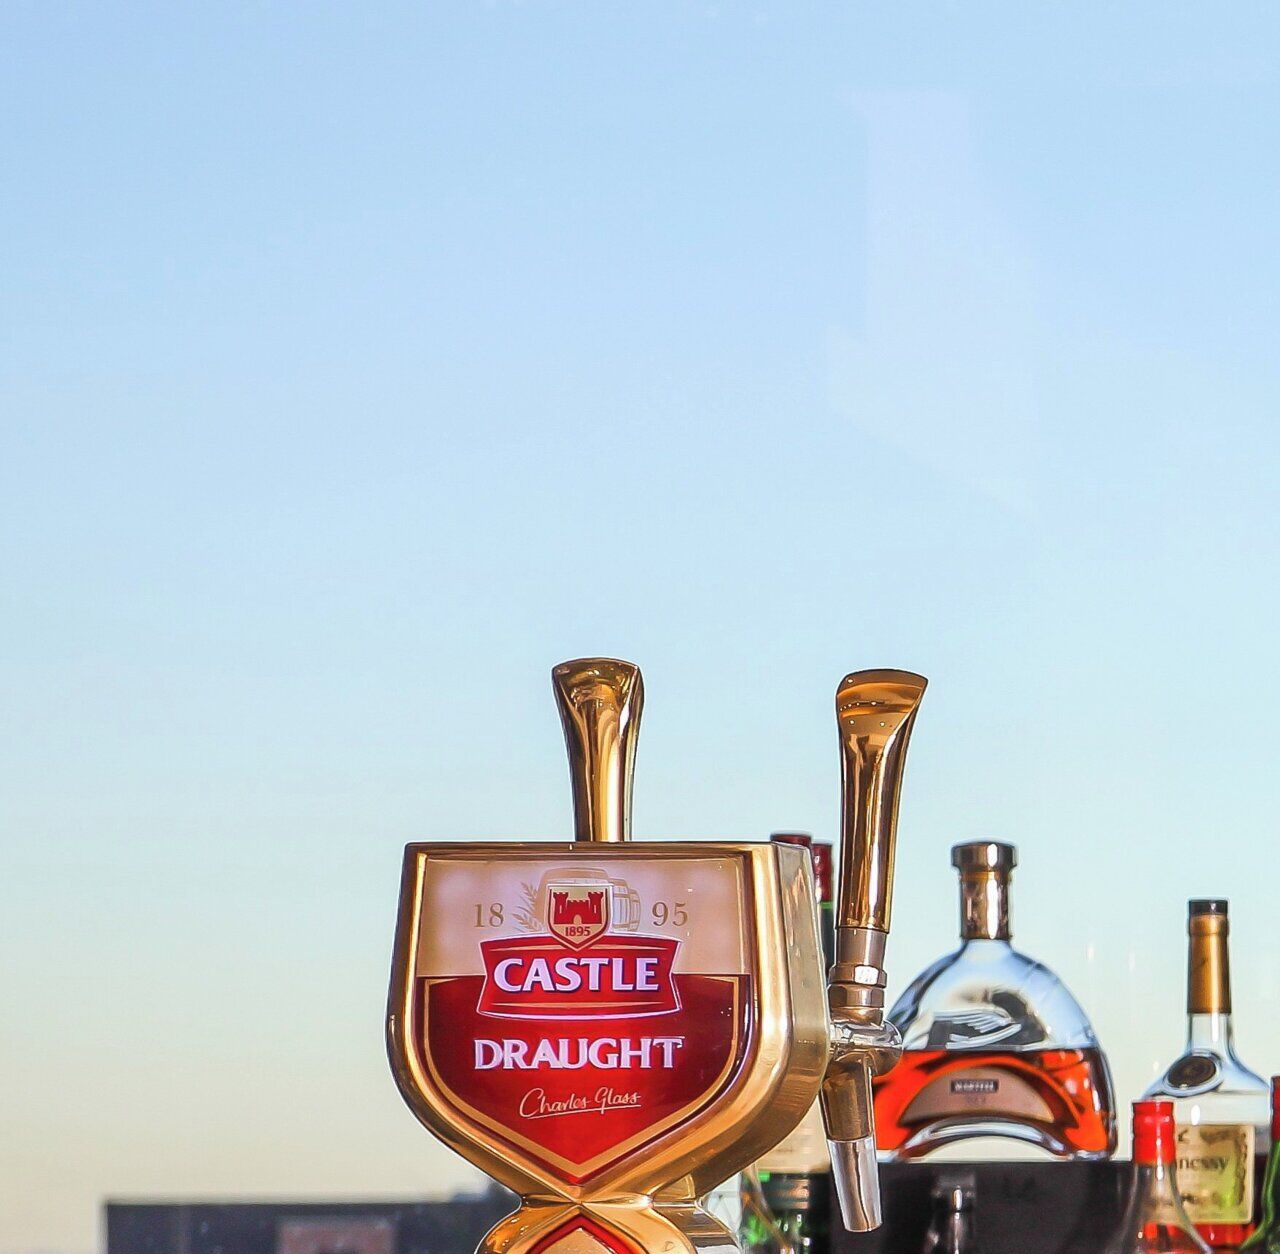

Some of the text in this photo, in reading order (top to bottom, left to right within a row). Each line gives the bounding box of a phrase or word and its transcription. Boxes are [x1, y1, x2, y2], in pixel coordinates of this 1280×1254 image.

[473, 901, 689, 928] 18 95
[564, 925, 592, 938] 1895
[493, 957, 660, 993] CASTLE
[473, 1036, 686, 1070] DRAUGHT
[519, 1086, 642, 1118] Charles Glass
